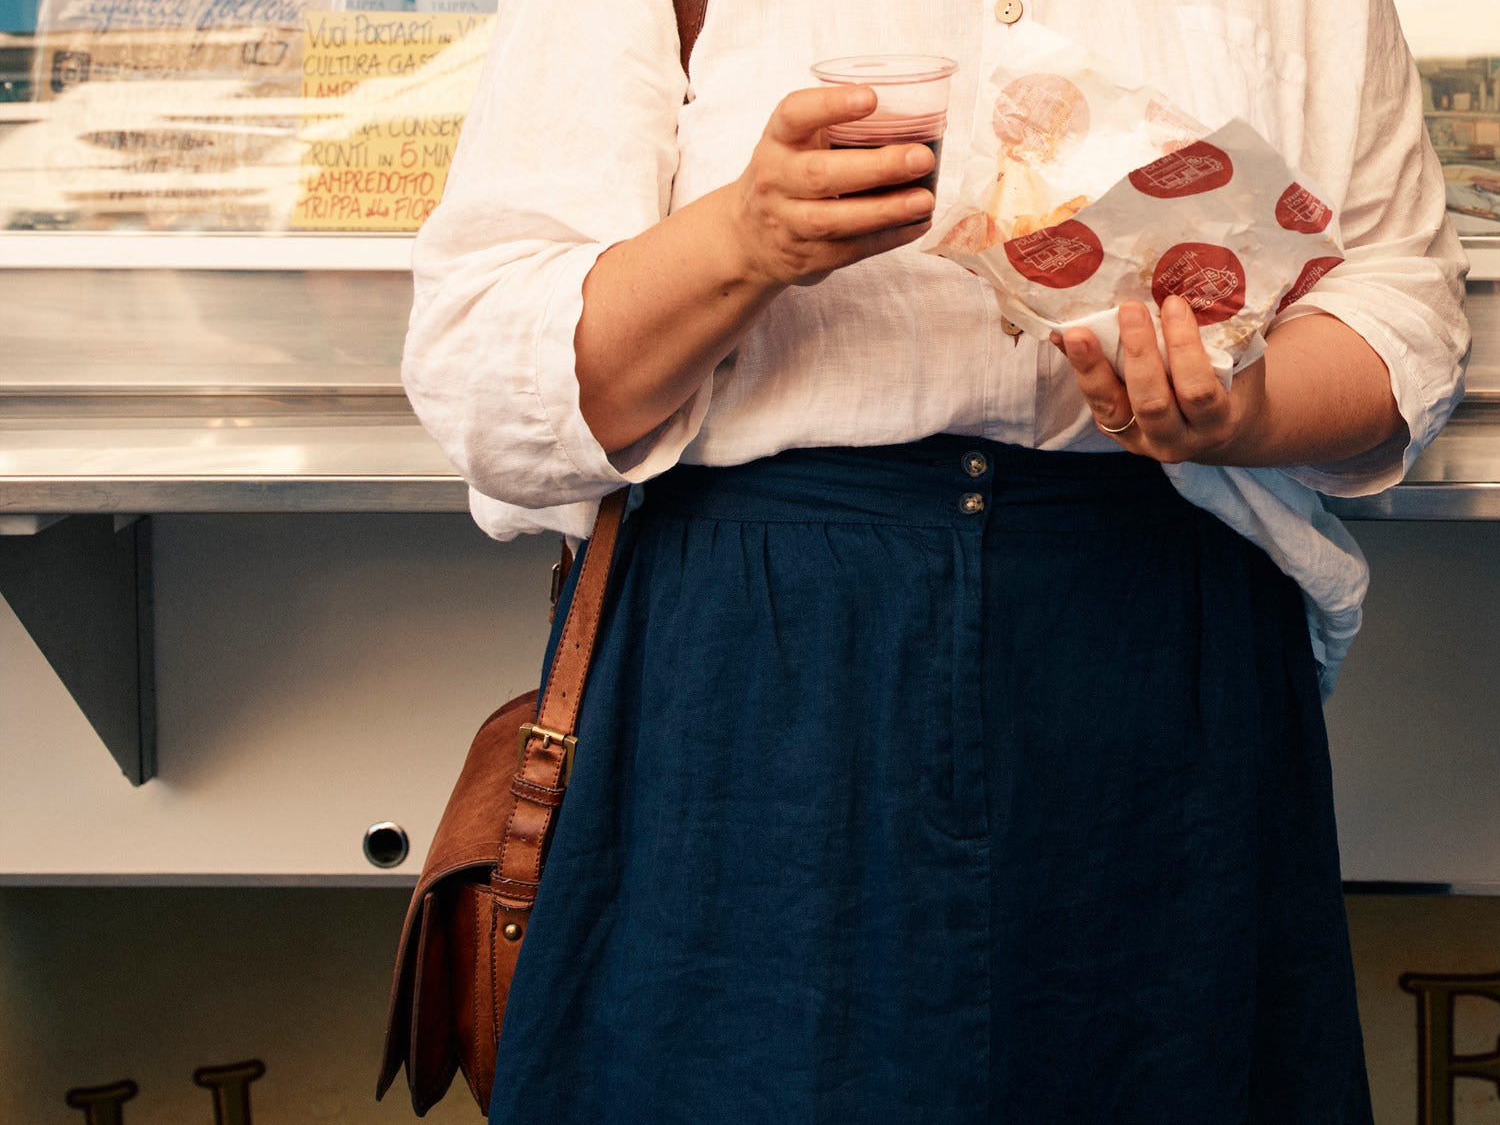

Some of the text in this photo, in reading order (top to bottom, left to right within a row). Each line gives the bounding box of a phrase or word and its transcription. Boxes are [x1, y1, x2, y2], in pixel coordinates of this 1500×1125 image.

[304, 53, 381, 77] CULTURA
[400, 140, 418, 169] 5
[307, 170, 434, 196] LAMPREDOTTO
[297, 195, 361, 220] TRIPPA
